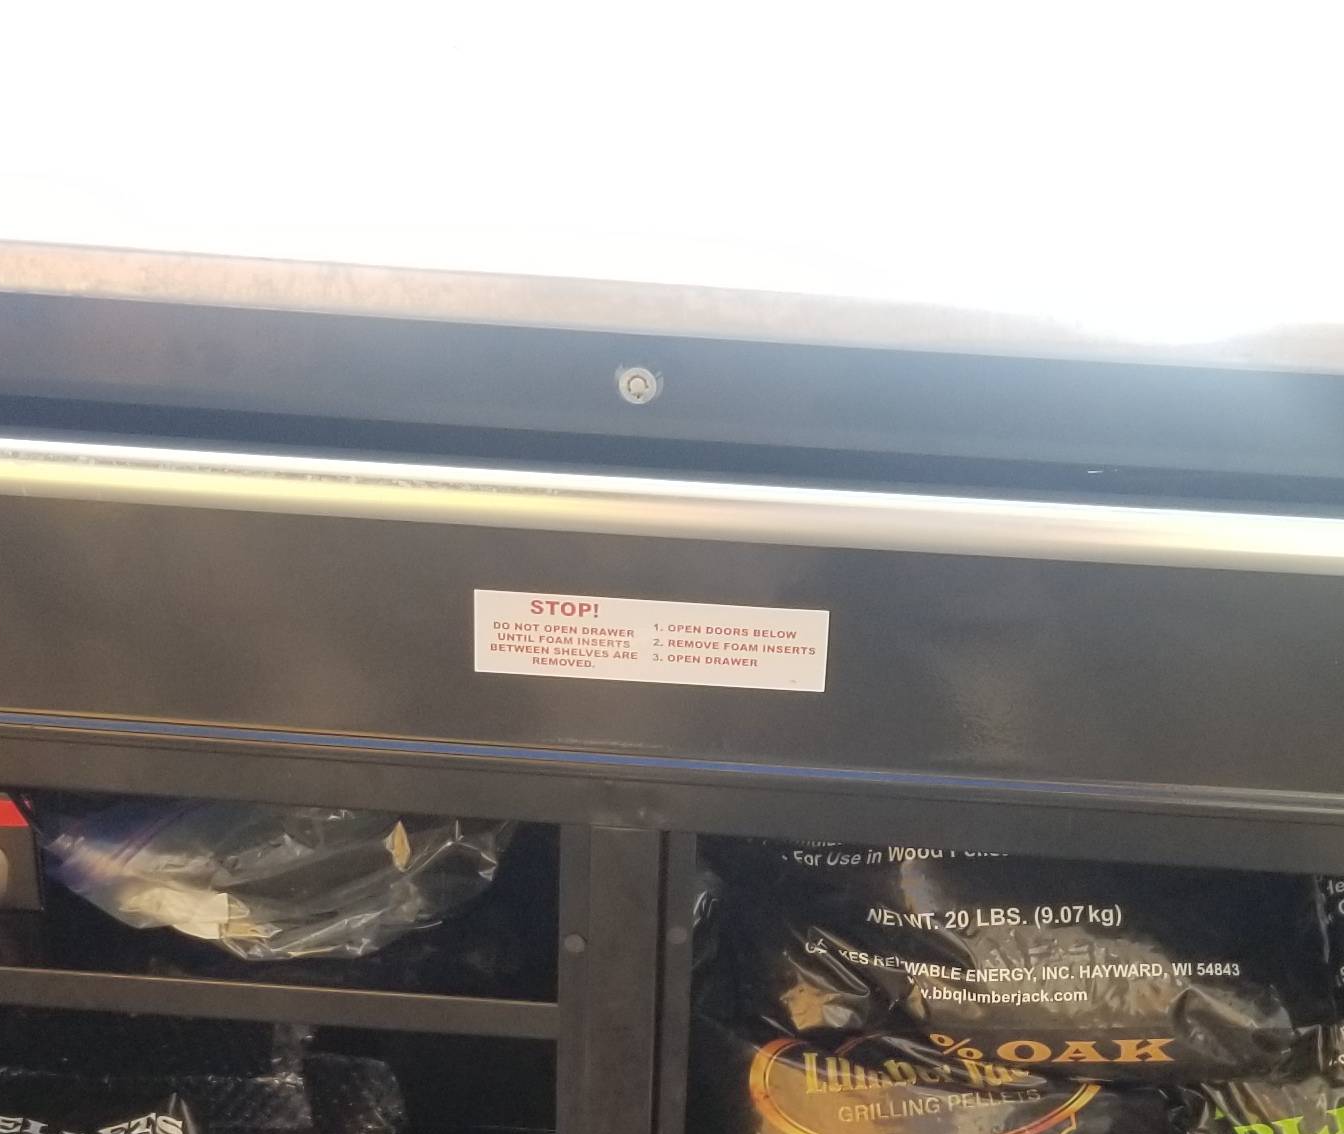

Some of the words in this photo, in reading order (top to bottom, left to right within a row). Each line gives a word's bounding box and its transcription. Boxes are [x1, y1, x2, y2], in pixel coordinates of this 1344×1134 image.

[530, 599, 599, 618] STOP!
[493, 621, 510, 630] DO
[514, 622, 540, 632] NOT
[544, 624, 578, 634] OPEN
[582, 627, 635, 638] DRAWER
[667, 624, 702, 634] OPEN
[705, 626, 749, 637] DOORS
[753, 629, 797, 639] BELOW
[497, 632, 535, 643] UNTIL
[539, 635, 574, 645] FOAM
[577, 637, 631, 648] INSERTS
[668, 639, 720, 650] REMOVE
[723, 642, 759, 652] FOAM
[762, 645, 816, 656] INSERTS
[490, 643, 550, 654] BETWEEN
[553, 647, 609, 658] SHELVES
[613, 651, 639, 660] ARE
[532, 656, 596, 668] REMOVED.
[667, 654, 701, 664] OPEN
[705, 656, 758, 667] DRAWER
[827, 851, 862, 867] Use
[866, 849, 882, 864] in
[905, 913, 939, 930] WT.
[945, 911, 970, 929] 20
[976, 908, 1028, 928] LBS.
[1034, 905, 1086, 930] (9.07
[1088, 904, 1122, 927] kg)
[965, 967, 1038, 983] ENERGY,
[1042, 966, 1074, 980] INC.
[1079, 963, 1169, 980] HAYWARD,
[1172, 962, 1192, 977] WI
[1197, 962, 1240, 977] 54843
[996, 1038, 1175, 1063] OAK
[837, 1098, 941, 1123] GRILLING
[946, 1089, 1042, 1112] PELLETS
